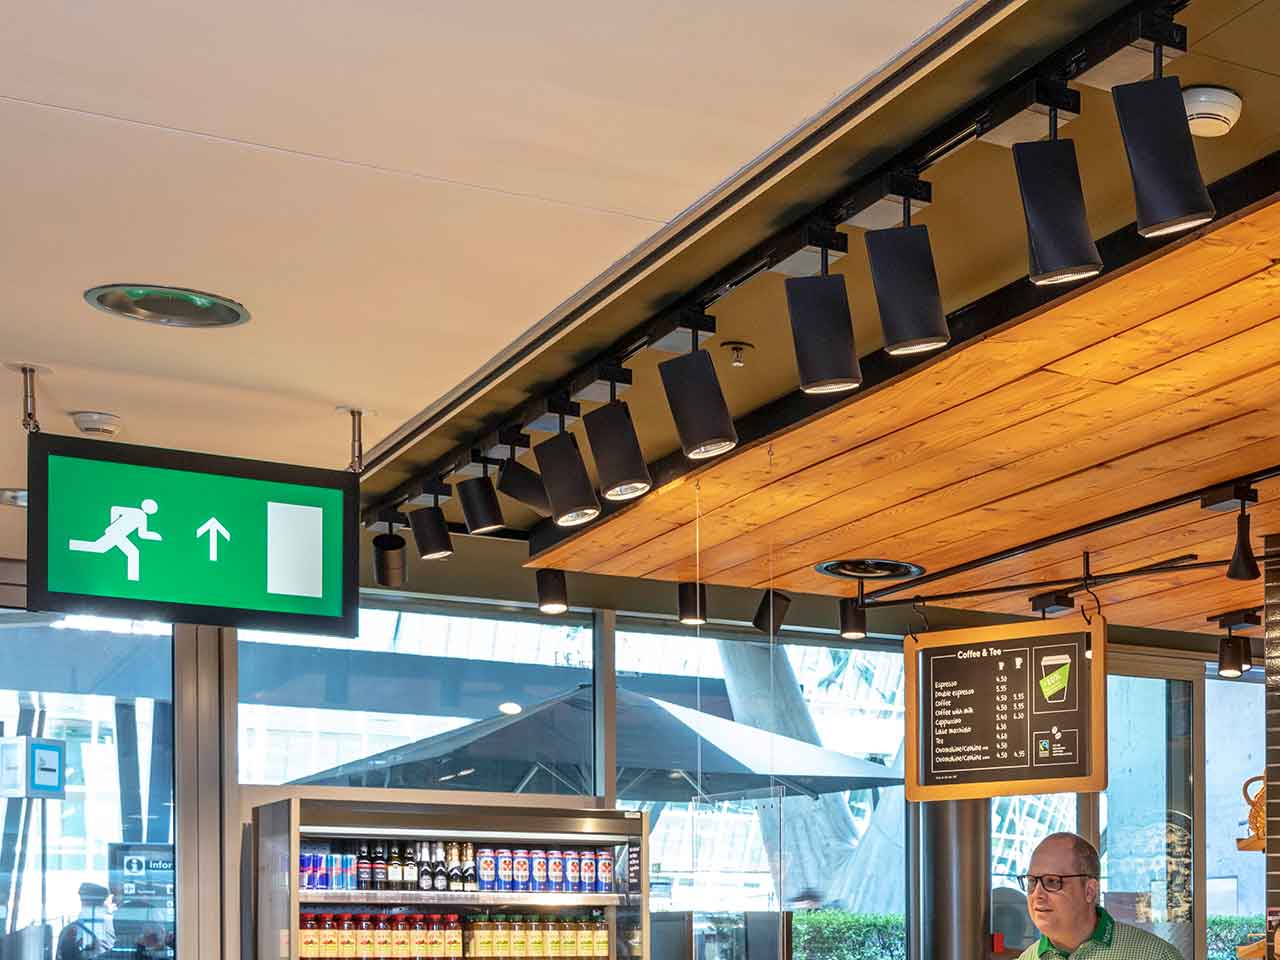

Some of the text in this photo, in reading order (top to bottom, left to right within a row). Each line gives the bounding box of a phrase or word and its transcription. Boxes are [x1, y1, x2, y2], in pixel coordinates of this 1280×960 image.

[957, 650, 980, 659] Coffee
[982, 648, 988, 657] &
[935, 680, 957, 690] Espresso
